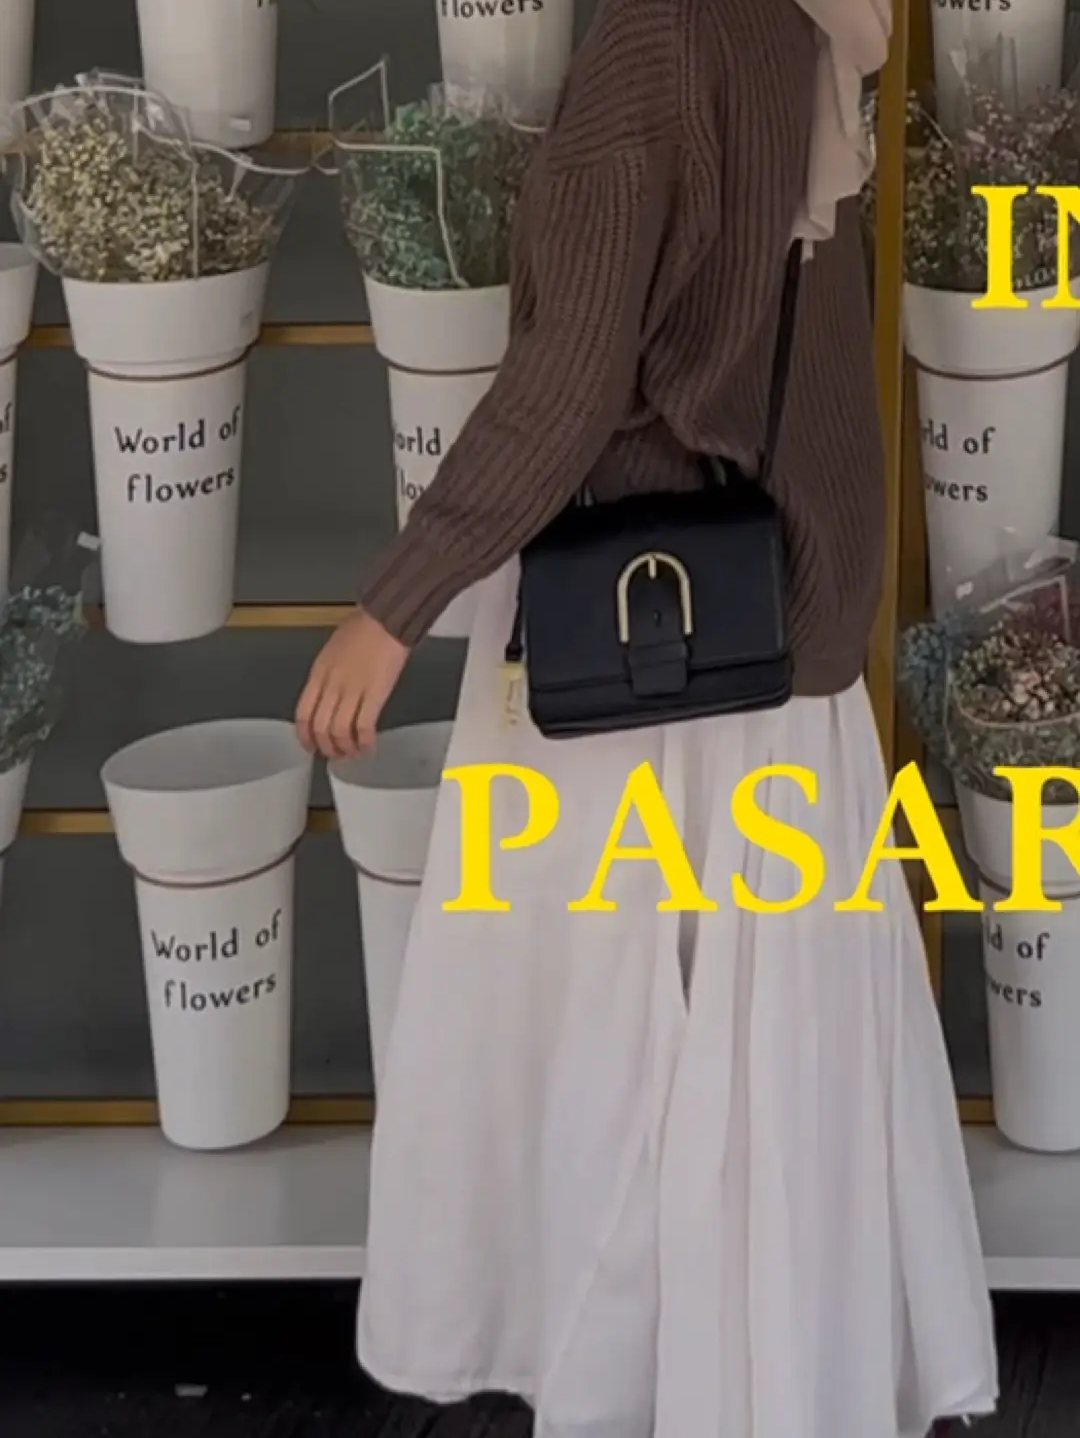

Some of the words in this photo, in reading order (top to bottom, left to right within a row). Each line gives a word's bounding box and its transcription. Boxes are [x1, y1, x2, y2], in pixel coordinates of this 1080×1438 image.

[114, 419, 205, 455] World
[219, 405, 241, 441] of
[963, 426, 996, 455] of
[127, 466, 235, 503] flowers
[151, 927, 238, 963] World
[254, 908, 282, 947] of
[1017, 931, 1051, 961] of
[163, 972, 276, 1012] flowers
